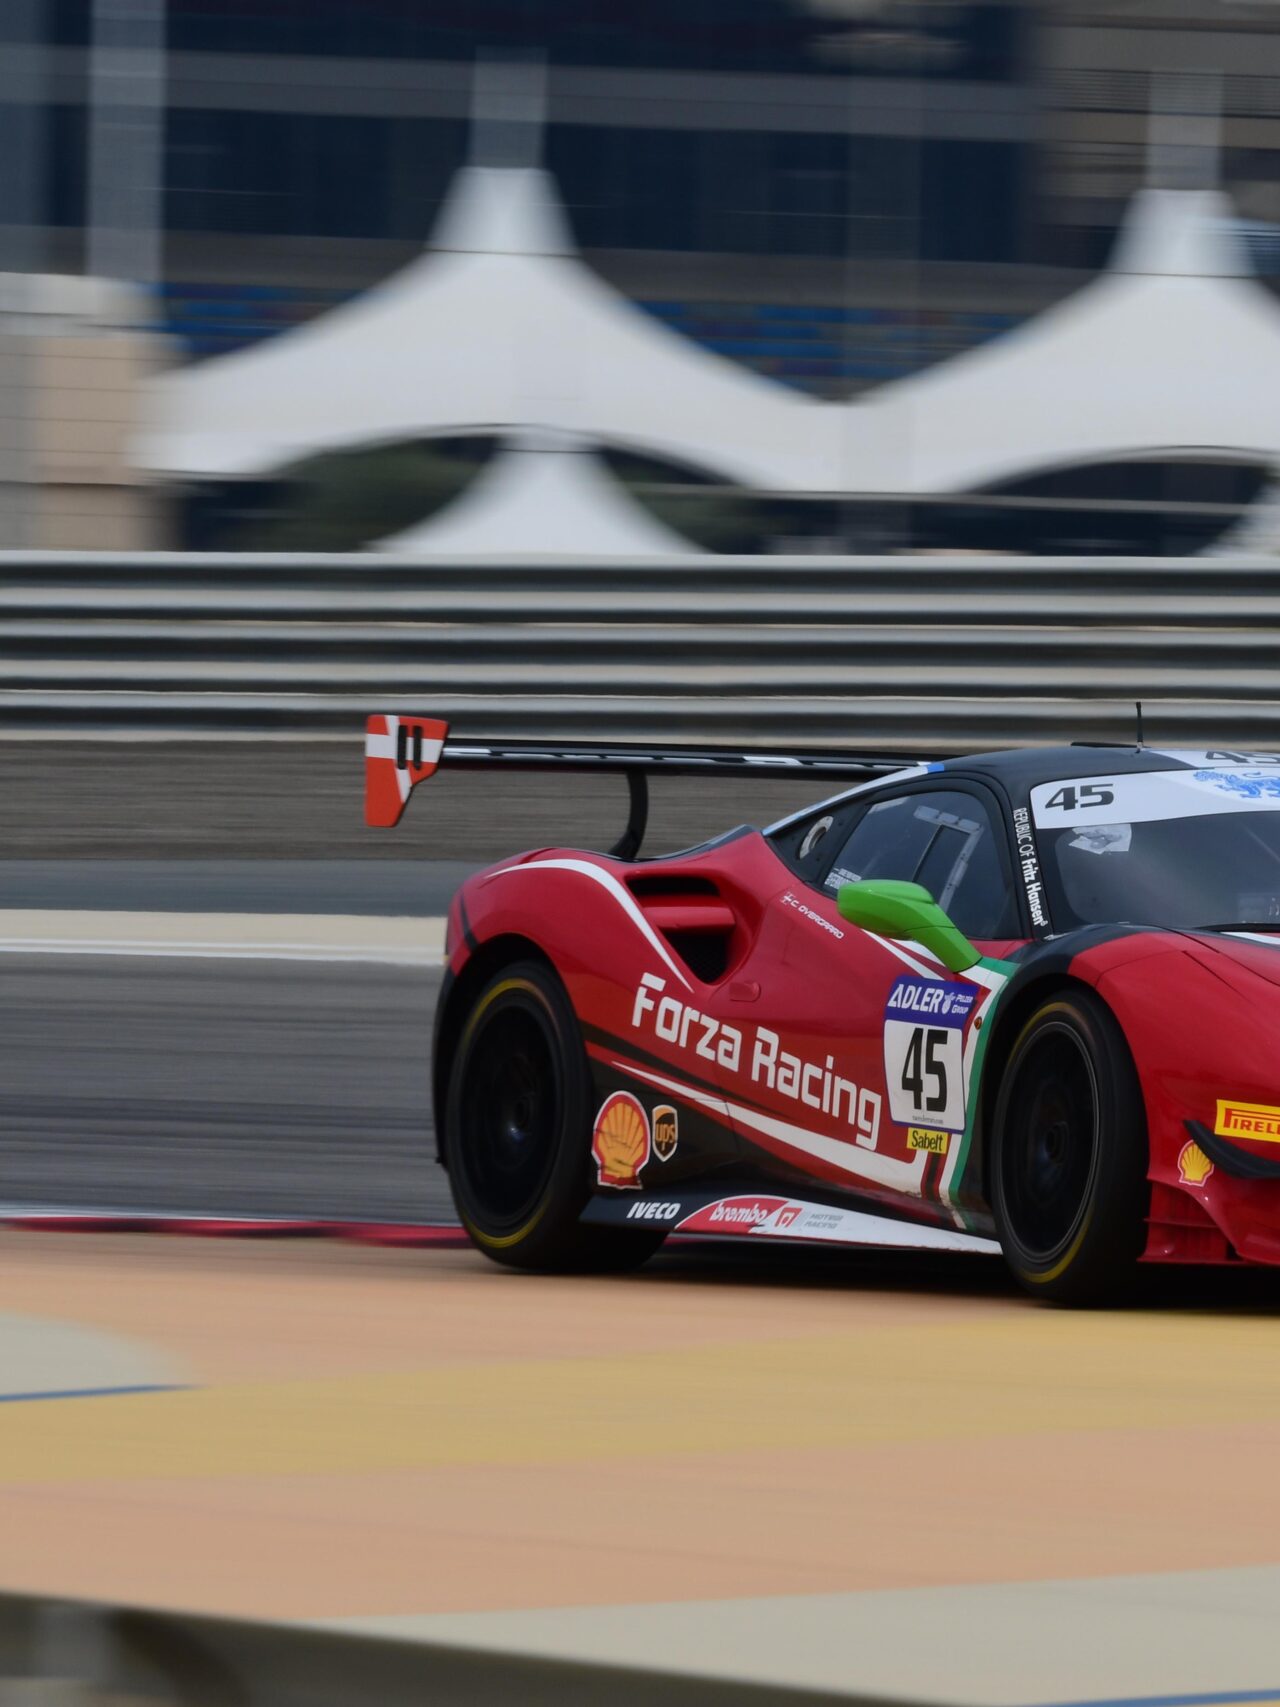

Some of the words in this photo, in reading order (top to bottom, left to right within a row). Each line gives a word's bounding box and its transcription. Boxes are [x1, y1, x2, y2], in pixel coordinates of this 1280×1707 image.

[1044, 783, 1115, 812] 45
[1013, 807, 1033, 844] REPUBLIC
[1019, 844, 1035, 858] OF
[1021, 857, 1039, 883] Fritz
[887, 983, 945, 1014] ADLER
[632, 972, 742, 1072] Forza
[751, 1026, 882, 1151] Racing
[902, 1027, 949, 1113] 45
[655, 1123, 675, 1152] ups
[911, 1130, 944, 1151] Sabelt
[626, 1202, 682, 1220] IVECO
[709, 1201, 769, 1224] brembo
